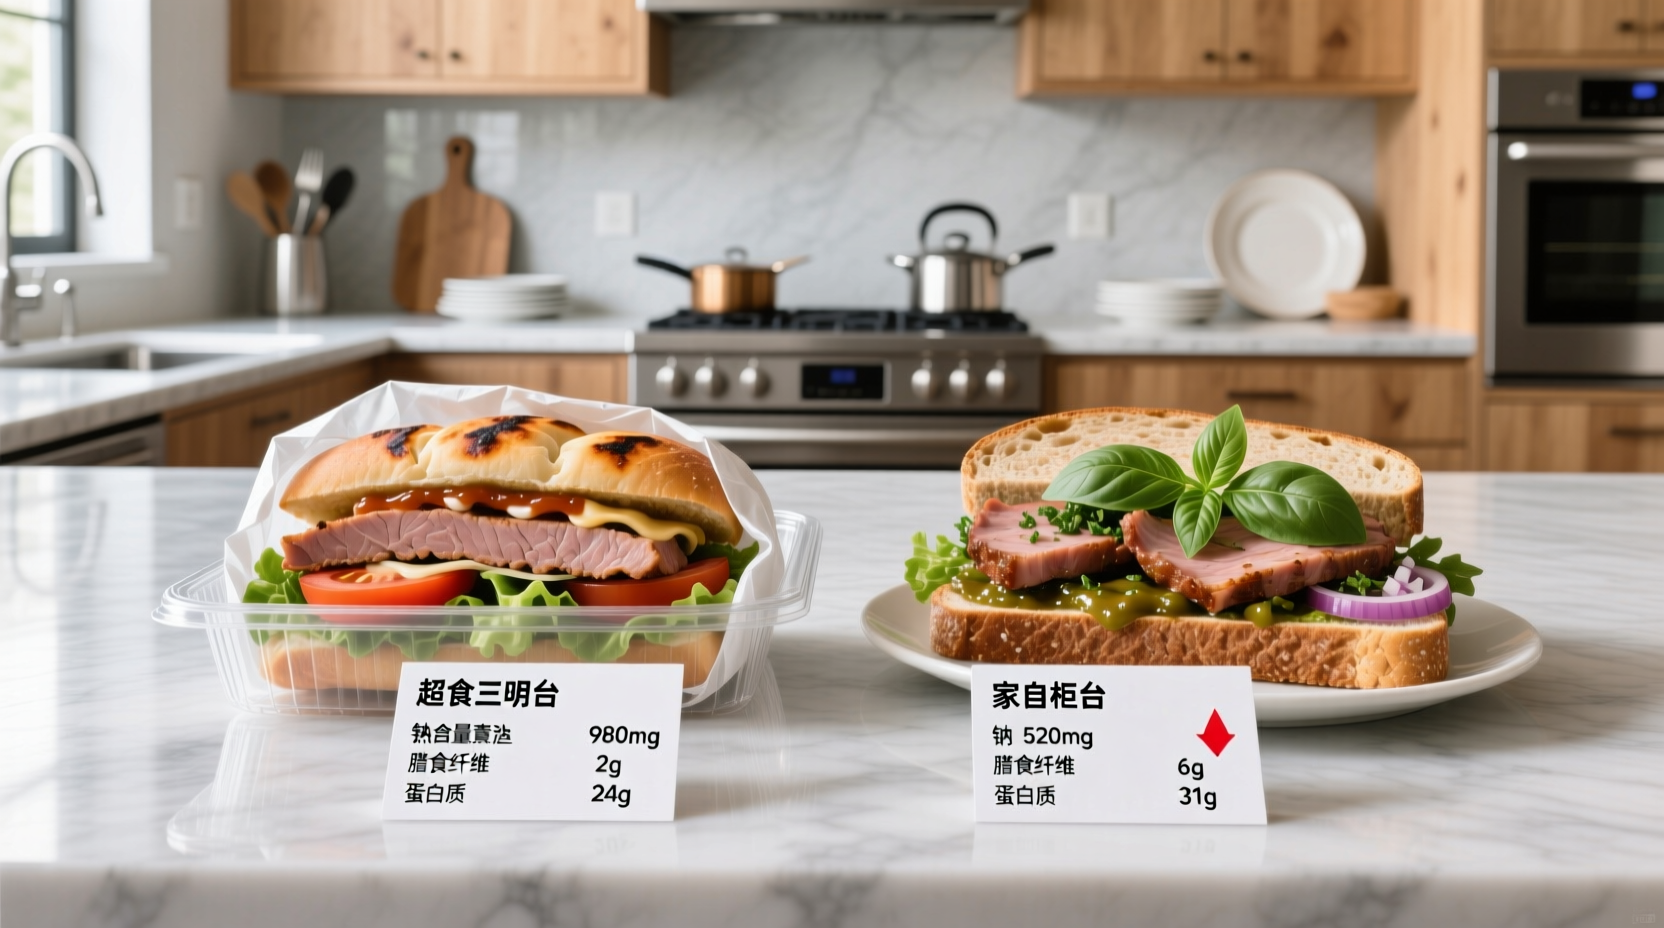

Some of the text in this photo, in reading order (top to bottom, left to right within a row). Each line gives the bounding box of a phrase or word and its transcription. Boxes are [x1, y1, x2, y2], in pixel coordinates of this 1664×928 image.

[415, 677, 560, 708] 超食三明台
[992, 680, 1106, 710] 家自柜台
[589, 725, 660, 750] 980mg
[992, 724, 1093, 751] 钠 520mg
[595, 754, 622, 779] 2g
[1177, 757, 1204, 781] 6g
[404, 782, 631, 809] 蛋白质 24g
[994, 784, 1217, 811] 蛋白质 31g
